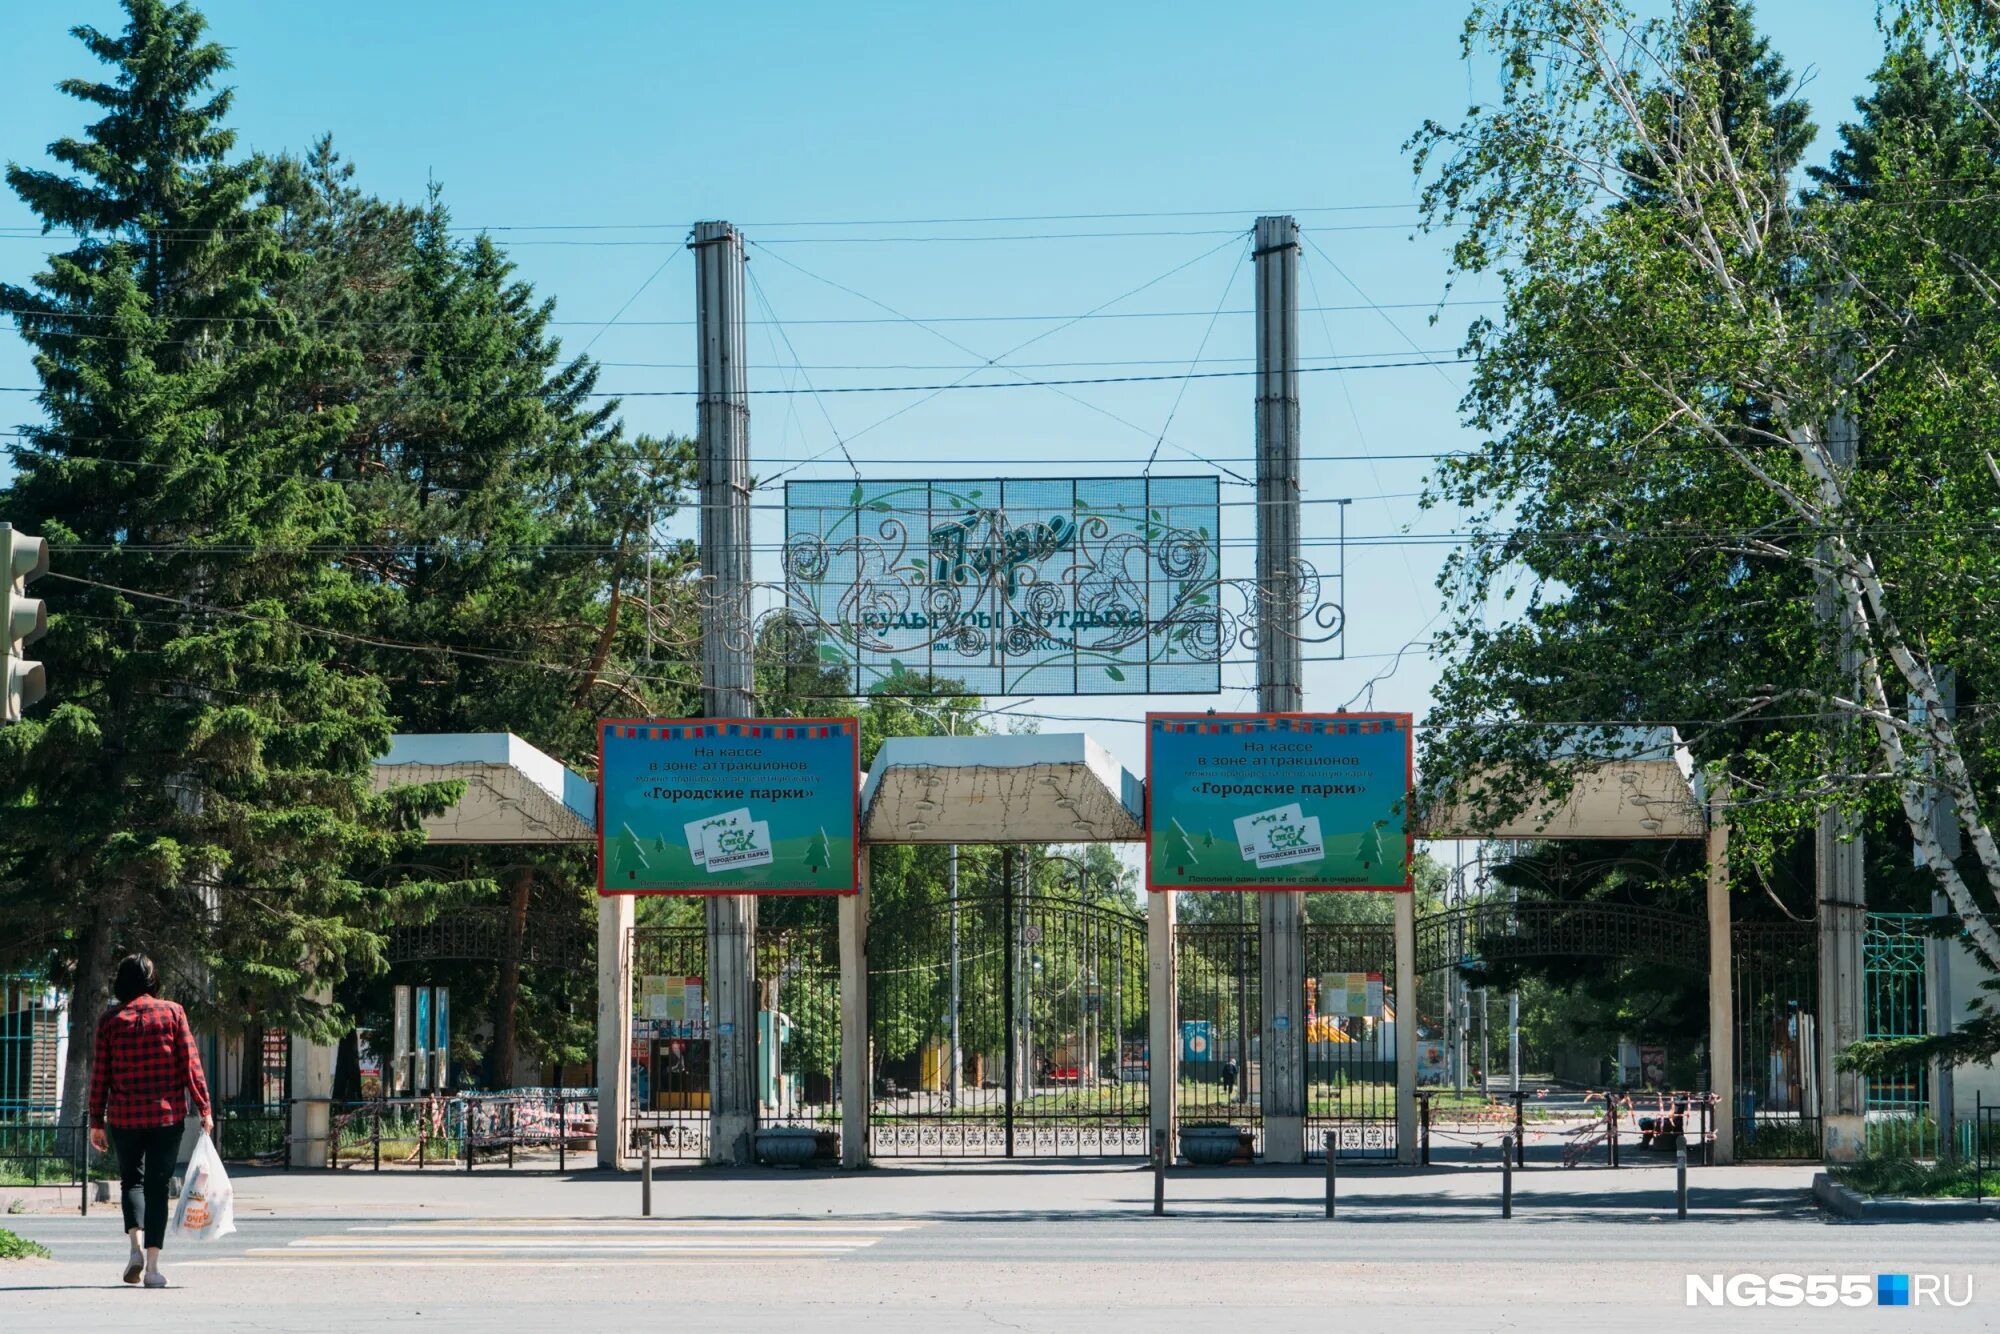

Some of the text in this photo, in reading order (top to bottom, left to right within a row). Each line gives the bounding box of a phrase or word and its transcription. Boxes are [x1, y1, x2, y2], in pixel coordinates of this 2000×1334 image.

[694, 747, 762, 757] На кассе
[1244, 742, 1313, 752] На кассе
[649, 762, 807, 773] в зоне аттракционов
[1198, 757, 1359, 768] в зоне аттракционов
[644, 787, 813, 803] «Городские парки»
[1192, 782, 1366, 798] «Городские парки»
